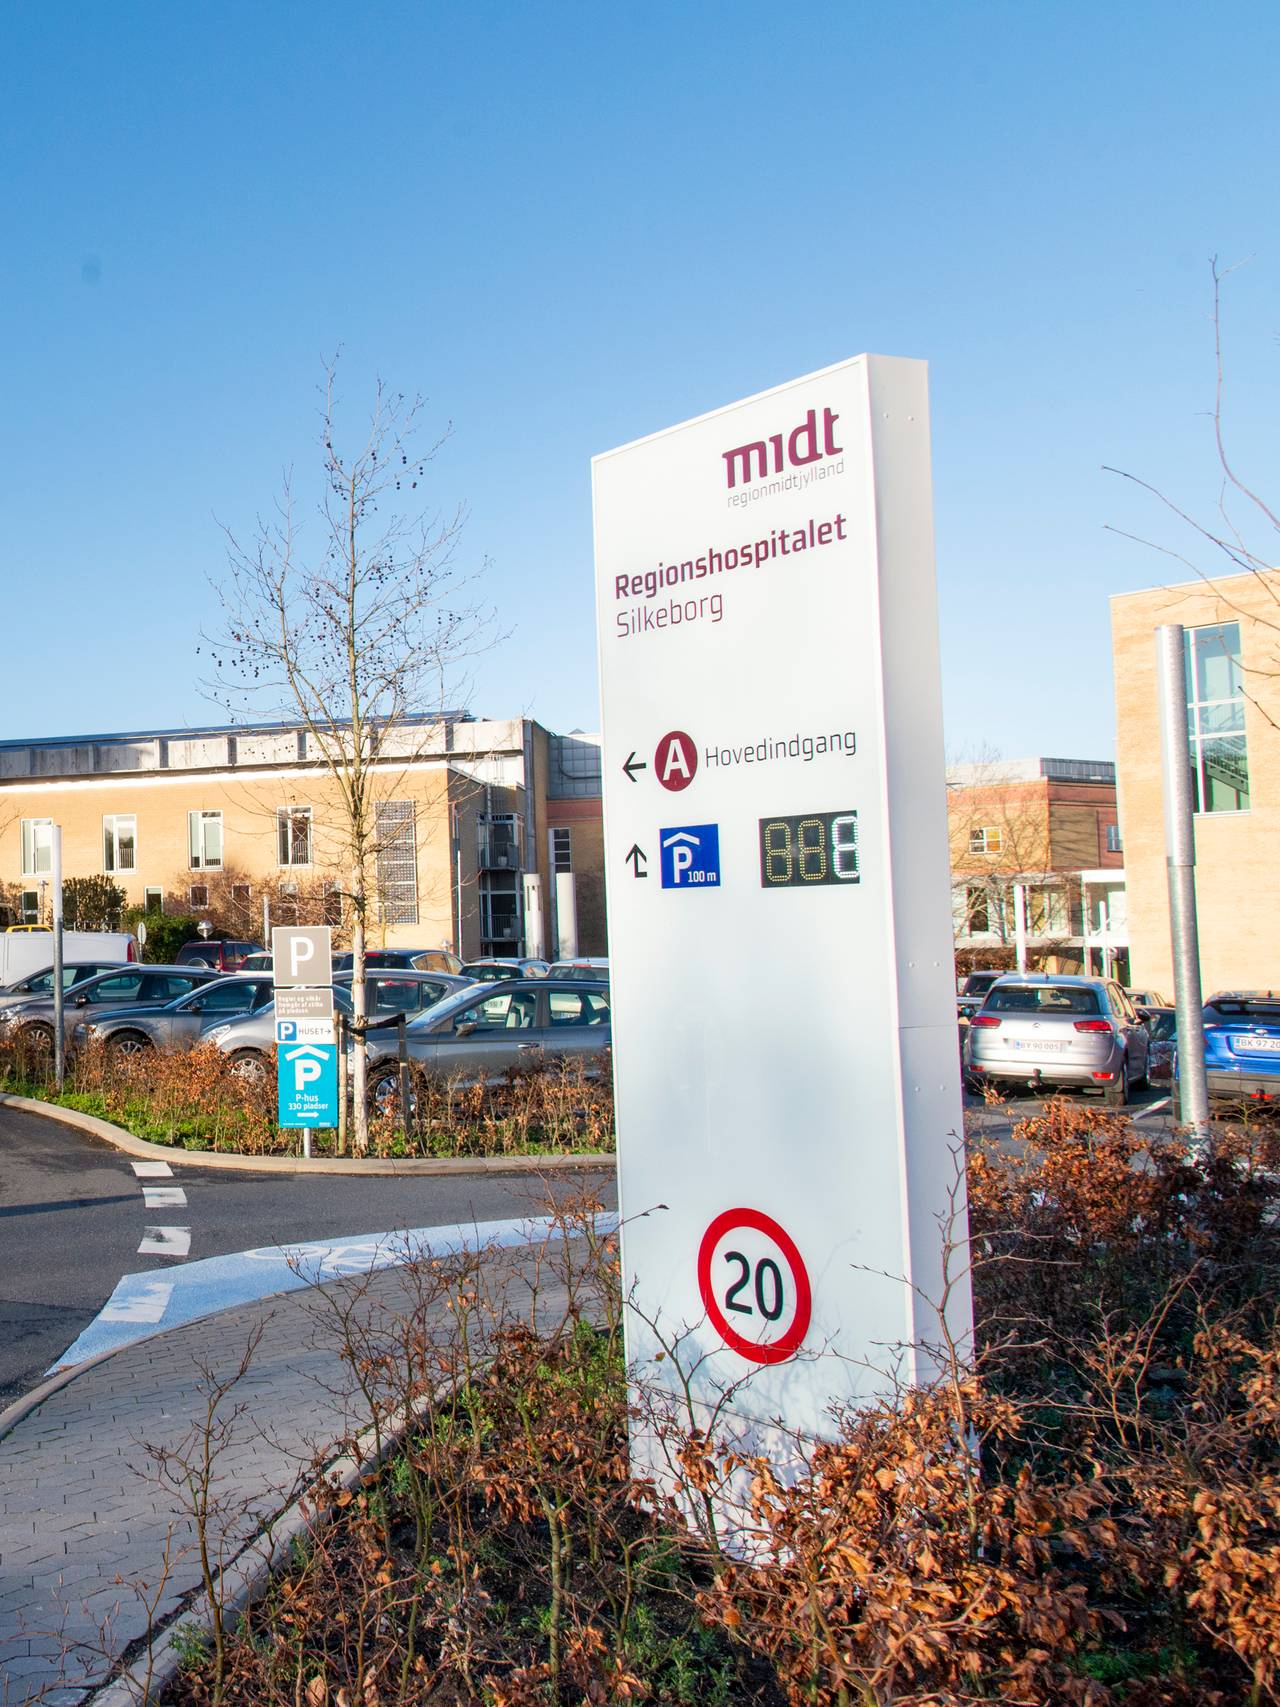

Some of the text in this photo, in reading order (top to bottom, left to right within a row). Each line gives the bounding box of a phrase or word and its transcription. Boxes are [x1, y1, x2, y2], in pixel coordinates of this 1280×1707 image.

[722, 407, 843, 488] midt
[727, 458, 845, 508] regionmidtjylland
[615, 514, 847, 599] Regionshospitalet
[616, 593, 723, 637] Silkeborg
[662, 731, 857, 781] A Hovedindgang
[673, 845, 693, 884] P
[687, 870, 717, 883] 100 m
[290, 936, 315, 977] P
[280, 1023, 294, 1040] P
[294, 1059, 322, 1091] P
[295, 1093, 319, 1102] P-hus
[303, 1102, 329, 1111] pladser
[724, 1251, 783, 1321] 20
